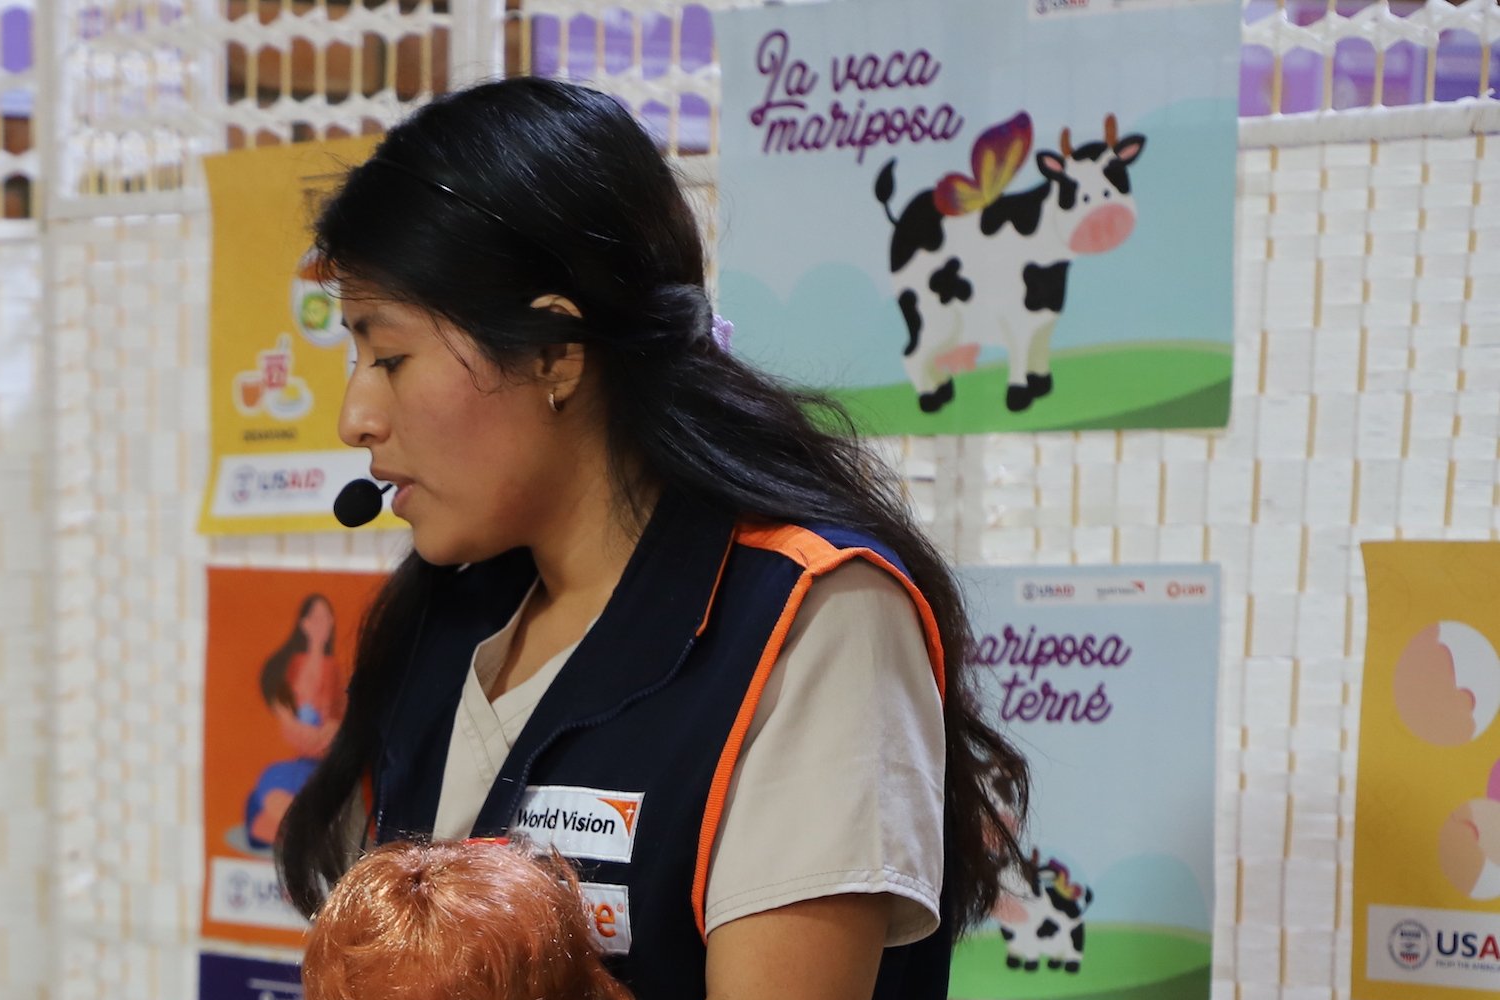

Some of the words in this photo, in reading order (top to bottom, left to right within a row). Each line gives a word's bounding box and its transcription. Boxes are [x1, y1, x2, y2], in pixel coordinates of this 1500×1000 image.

[750, 29, 819, 126] La
[831, 47, 942, 92] vaca
[762, 98, 965, 165] mariposa
[964, 623, 1132, 681] ariposa
[1000, 672, 1113, 724] terné
[517, 808, 559, 830] World
[562, 810, 616, 835] Vision
[1437, 930, 1500, 960] USA
